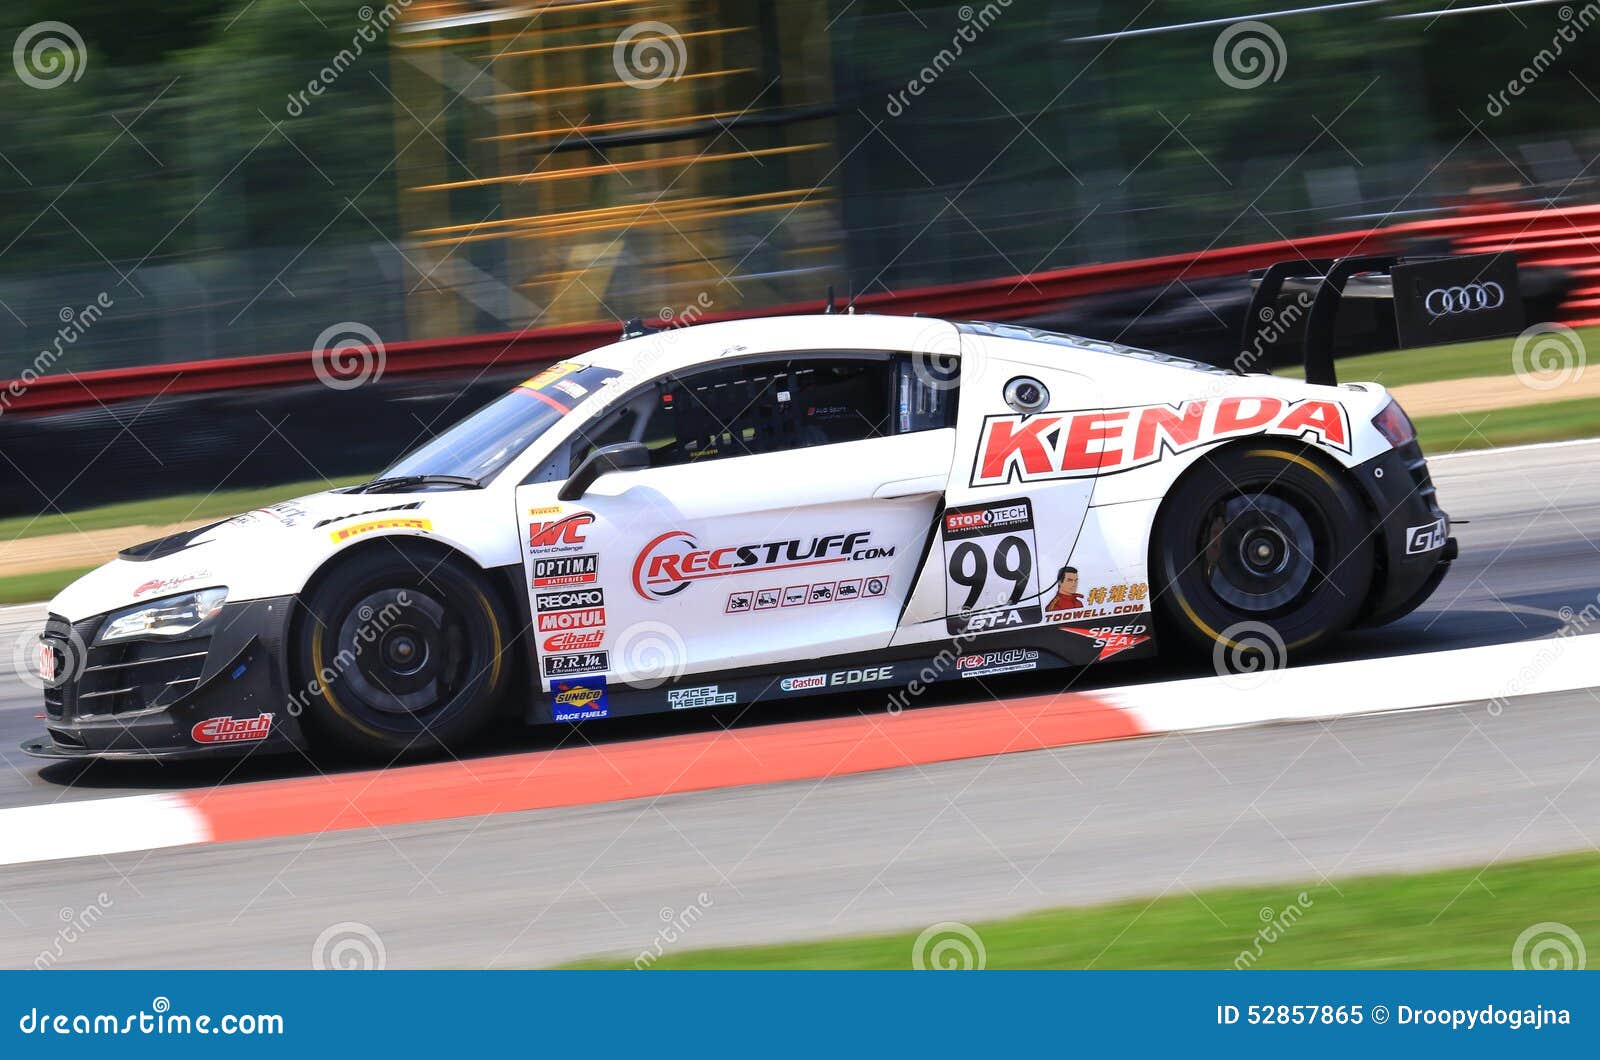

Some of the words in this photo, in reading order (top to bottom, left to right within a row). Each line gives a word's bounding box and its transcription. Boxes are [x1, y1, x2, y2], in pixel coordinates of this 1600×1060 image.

[976, 396, 1348, 481] KENDA
[528, 517, 593, 548] WC
[529, 547, 551, 555] World
[551, 545, 584, 554] Challenge
[537, 557, 595, 577] OPTIMA
[949, 535, 1032, 614] 99
[547, 576, 584, 585] BATTERIES
[537, 591, 602, 609] RECARO
[541, 611, 604, 630] MOTUL
[967, 610, 1023, 630] GT-A
[1045, 603, 1145, 623] TOOWELL.COM
[543, 630, 604, 651] Eibach
[1088, 624, 1147, 638] SPEED
[792, 677, 824, 689] Castrol
[830, 665, 894, 686] EDGE
[557, 690, 601, 703] SUNOCO
[673, 694, 736, 708] KEEPER
[556, 713, 581, 721] RACE
[581, 710, 608, 719] FUELS
[191, 714, 271, 743] Eibach
